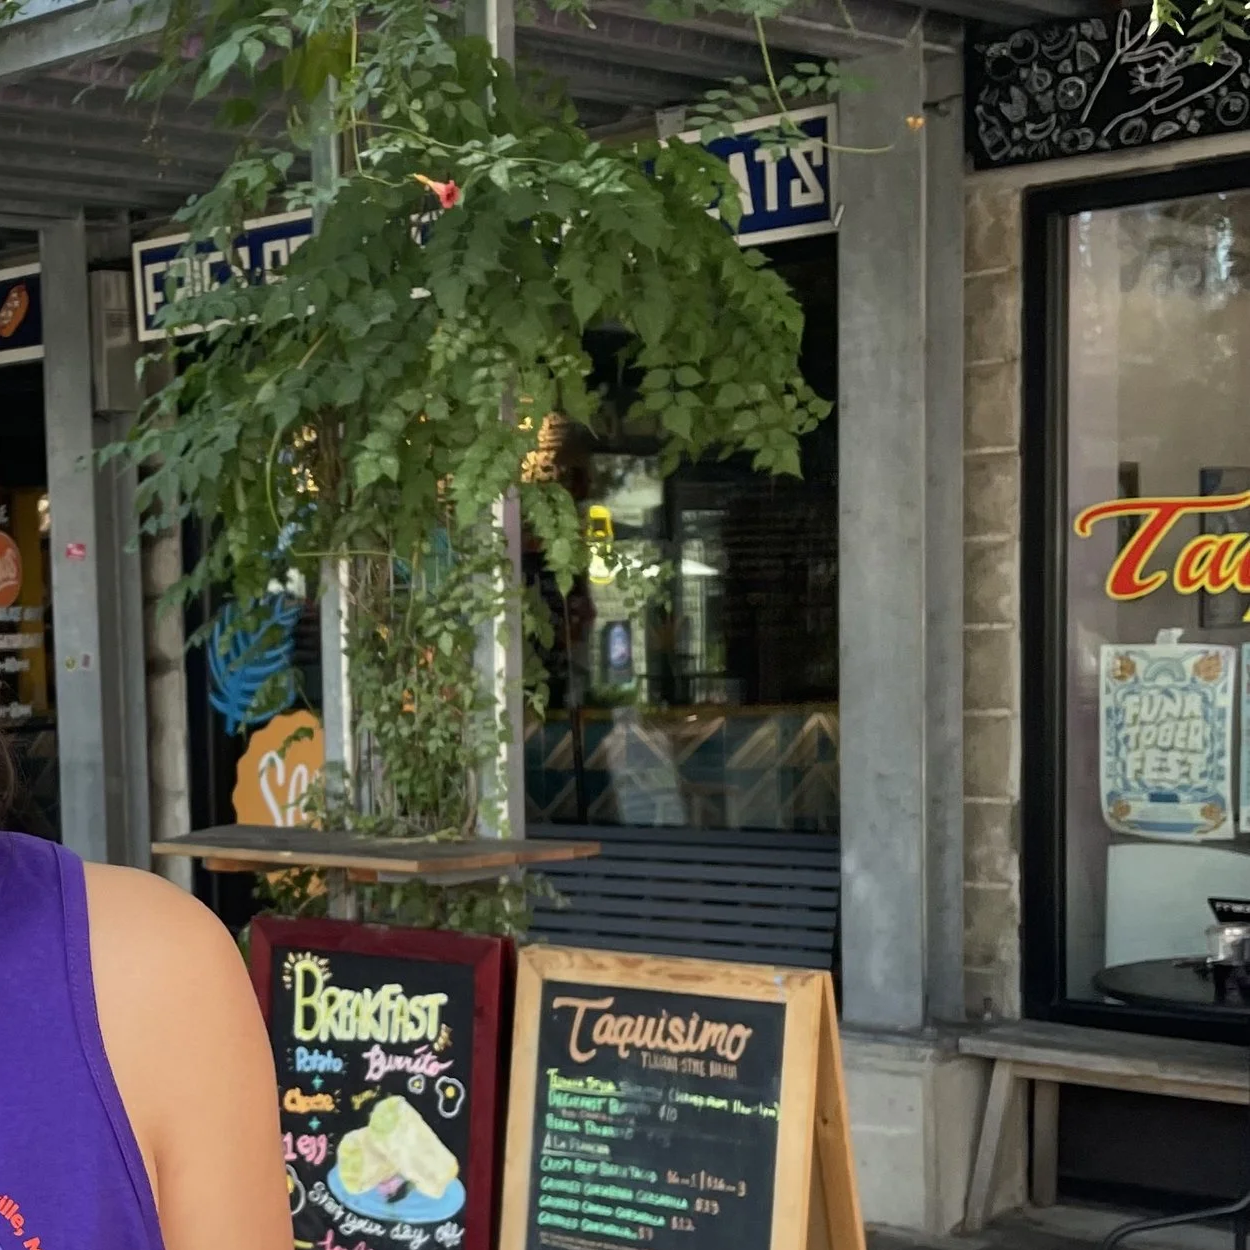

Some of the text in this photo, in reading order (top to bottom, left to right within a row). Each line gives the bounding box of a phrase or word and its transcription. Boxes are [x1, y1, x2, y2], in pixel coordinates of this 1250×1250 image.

[293, 959, 448, 1043] BREAKFAST
[553, 996, 753, 1063] Taquisimo
[362, 1043, 453, 1081] Burrito
[390, 1223, 430, 1250] day
